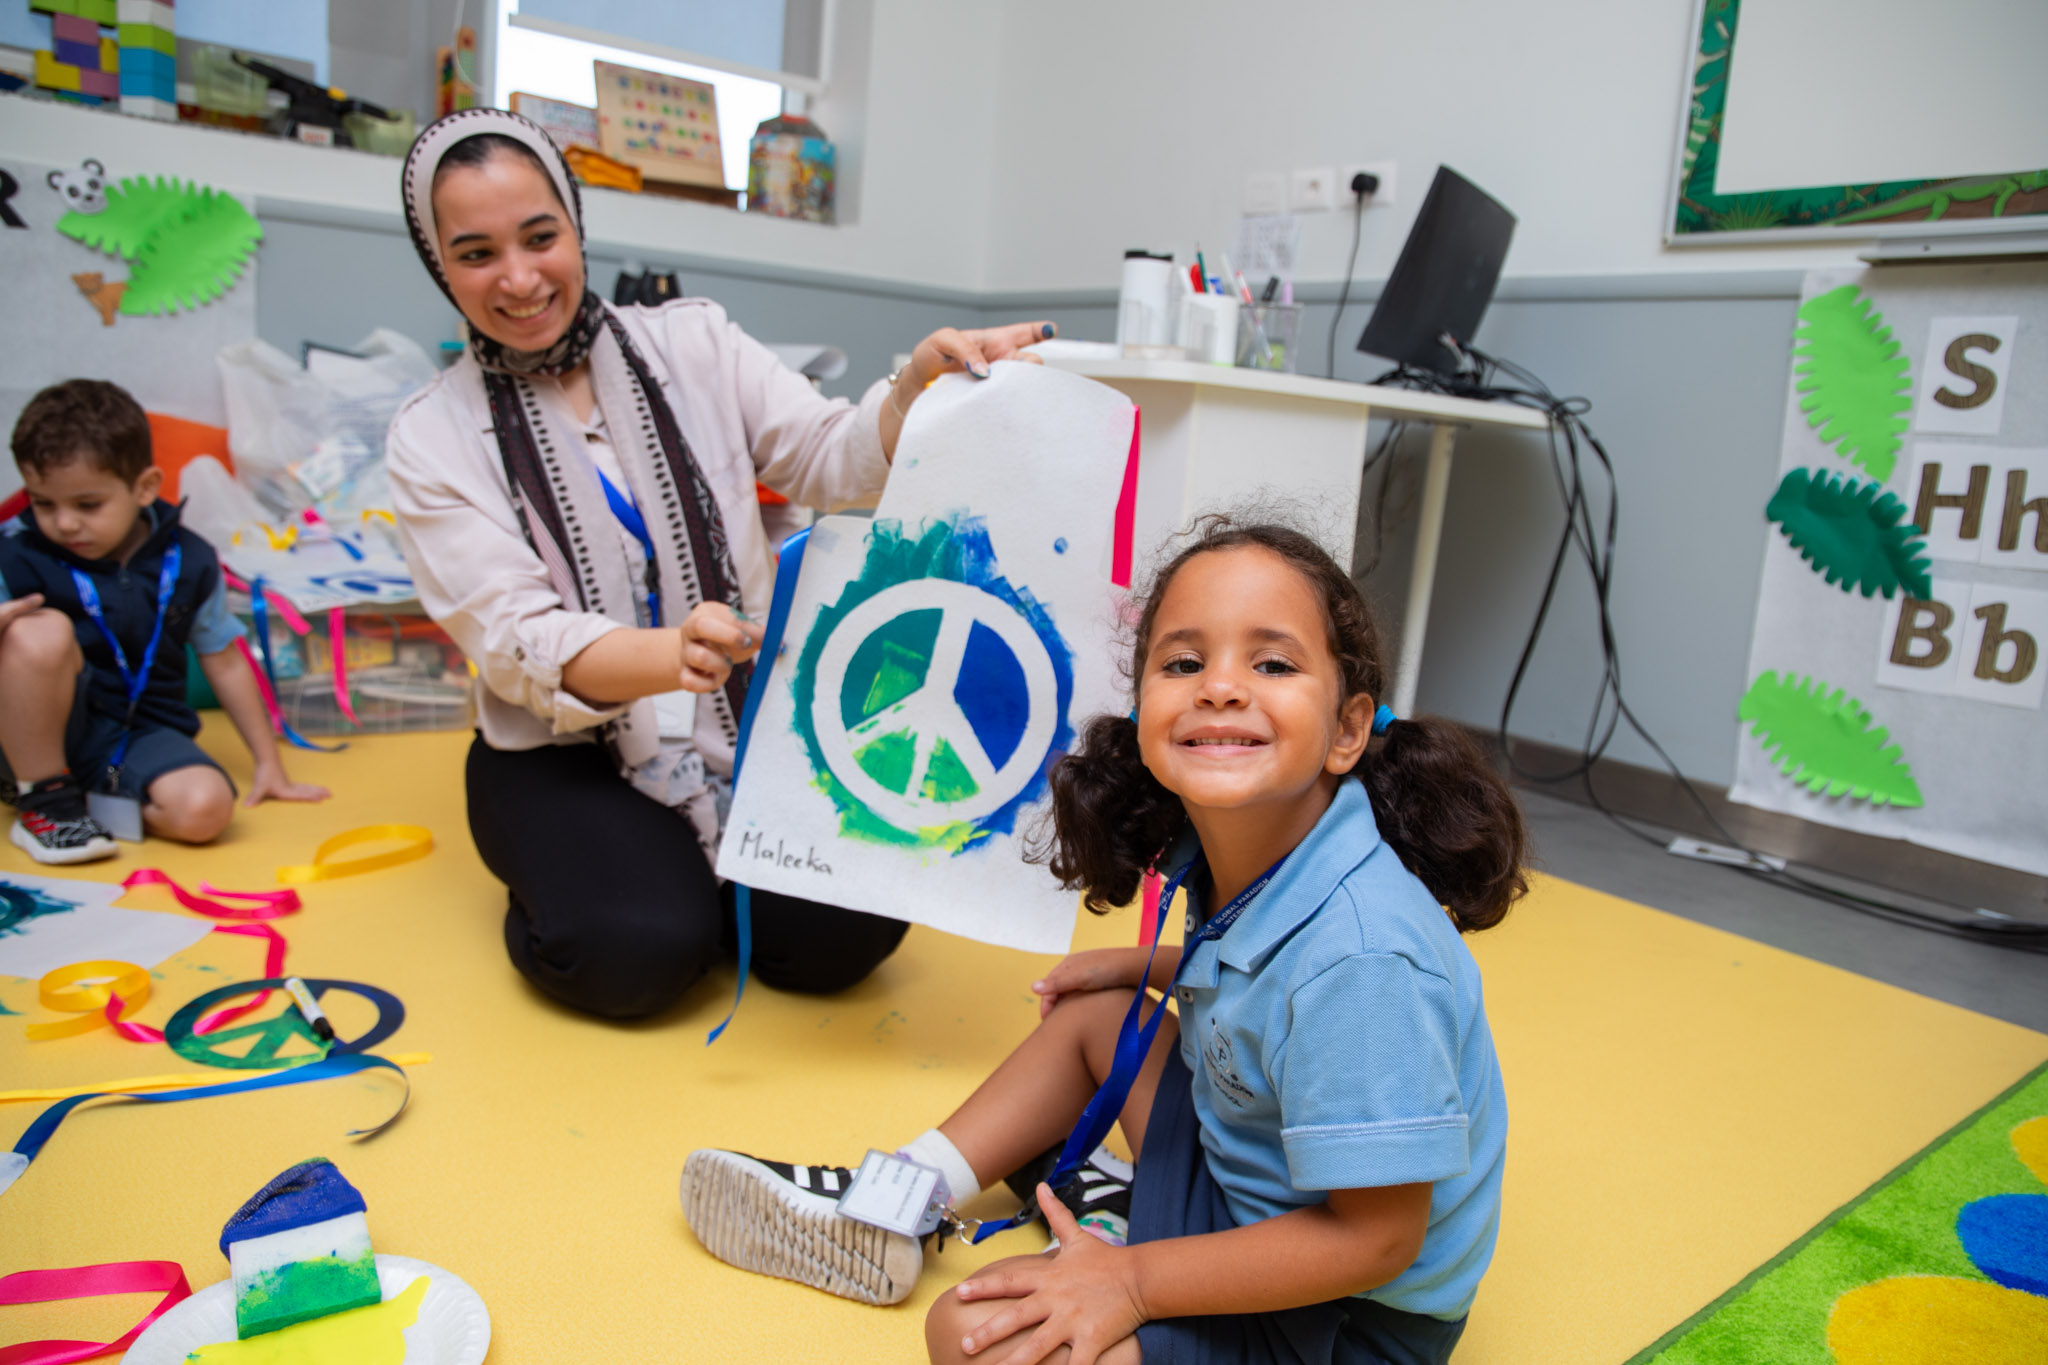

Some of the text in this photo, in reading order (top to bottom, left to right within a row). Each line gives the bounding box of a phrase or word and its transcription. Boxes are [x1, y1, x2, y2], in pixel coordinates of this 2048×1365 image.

[1934, 333, 2002, 410] S
[740, 831, 832, 875] Maleeka
[1215, 878, 1269, 924] GLOBAL PARADIGM
